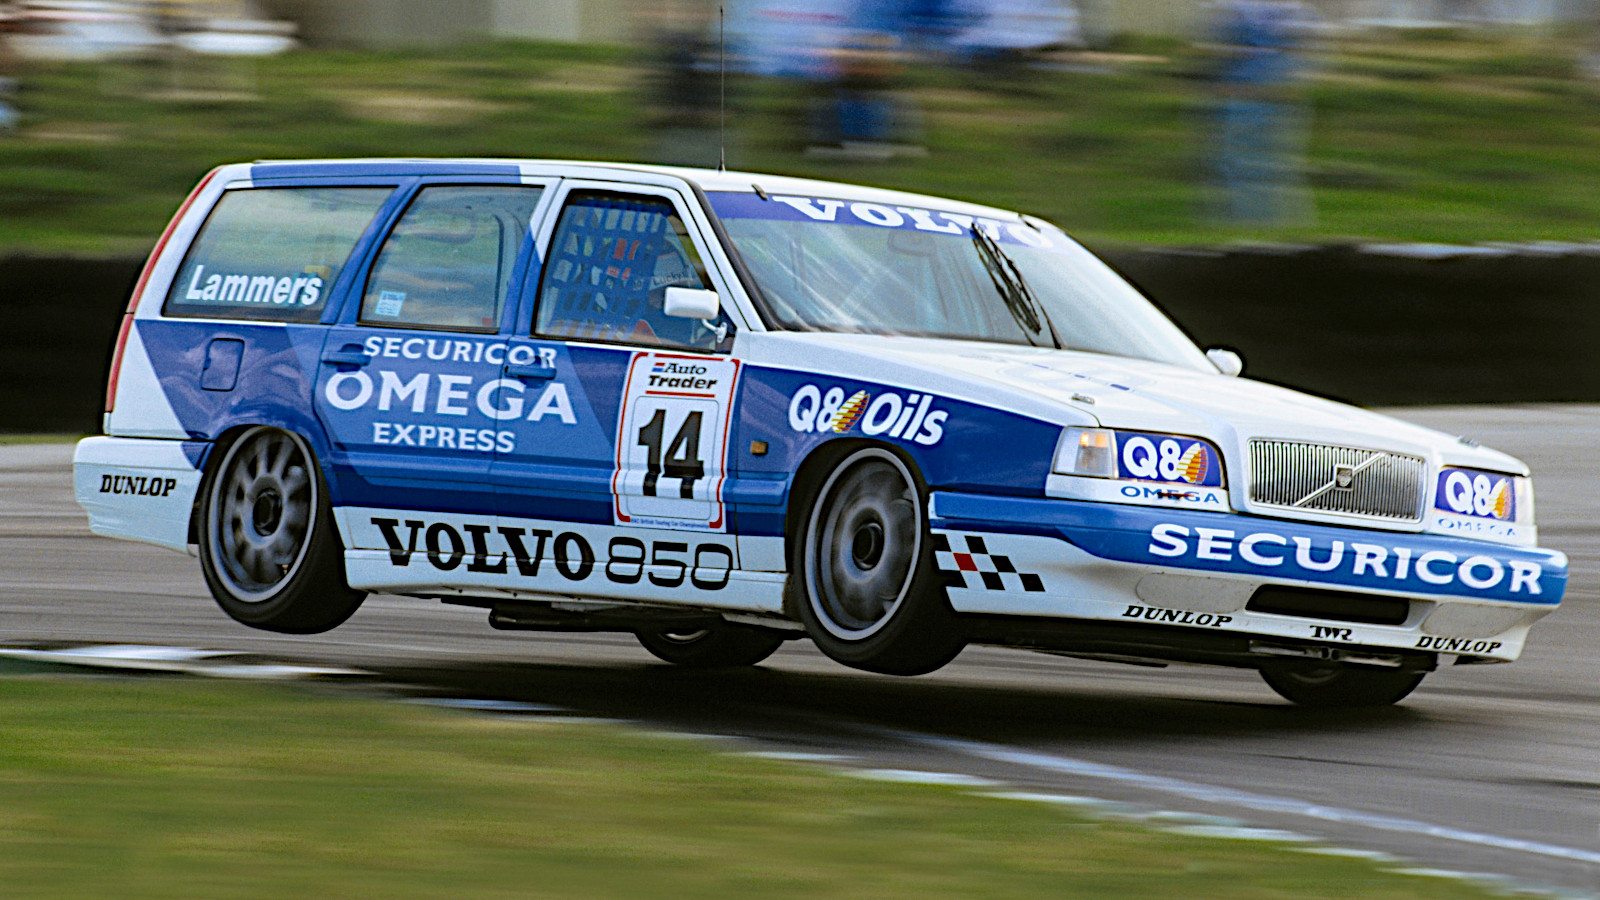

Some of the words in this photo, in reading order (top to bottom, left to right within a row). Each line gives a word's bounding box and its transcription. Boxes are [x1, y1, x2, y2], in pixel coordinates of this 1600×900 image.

[772, 195, 1053, 249] VOLVO
[186, 264, 322, 306] Lammers
[363, 336, 558, 369] SECURICOR
[664, 362, 707, 375] Auto
[325, 370, 577, 425] OMEGA
[648, 375, 718, 389] Trader
[788, 384, 845, 434] Q8
[861, 392, 949, 446] Oils
[372, 422, 515, 453] EXPRESS
[637, 408, 705, 500] 14
[1122, 436, 1182, 481] Q8
[100, 474, 177, 497] DUNLOP
[1120, 485, 1220, 504] OMEGA
[1445, 471, 1492, 516] Q8
[370, 517, 595, 581] VOLVO
[605, 536, 734, 591] 850
[1149, 523, 1543, 595] SECURICOR
[1122, 605, 1233, 628] DUNLOP
[1309, 625, 1353, 641] TWR
[1415, 635, 1502, 654] DUNLOP
